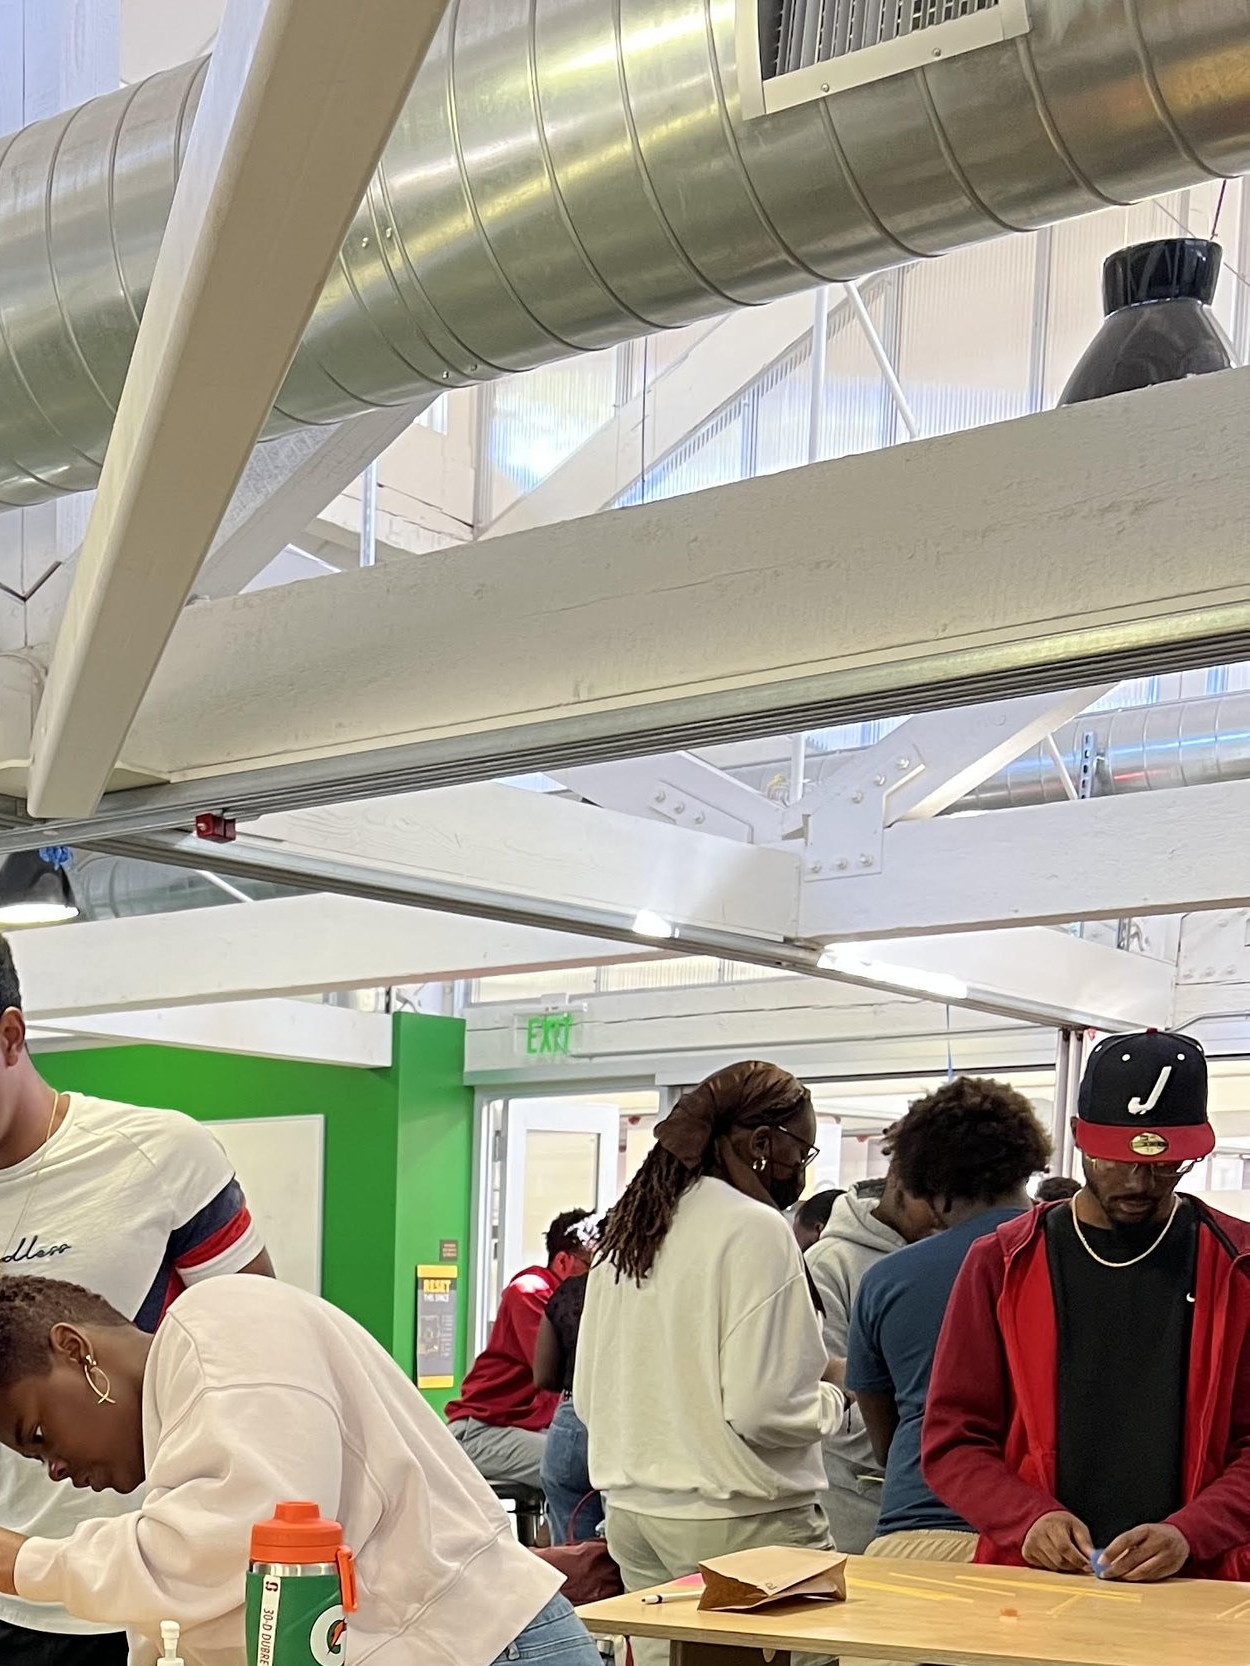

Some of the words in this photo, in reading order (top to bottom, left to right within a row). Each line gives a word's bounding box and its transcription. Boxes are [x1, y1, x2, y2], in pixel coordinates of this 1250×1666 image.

[527, 1016, 573, 1054] EXIT
[1127, 1065, 1172, 1115] J
[259, 1633, 272, 1666] DUBRE
